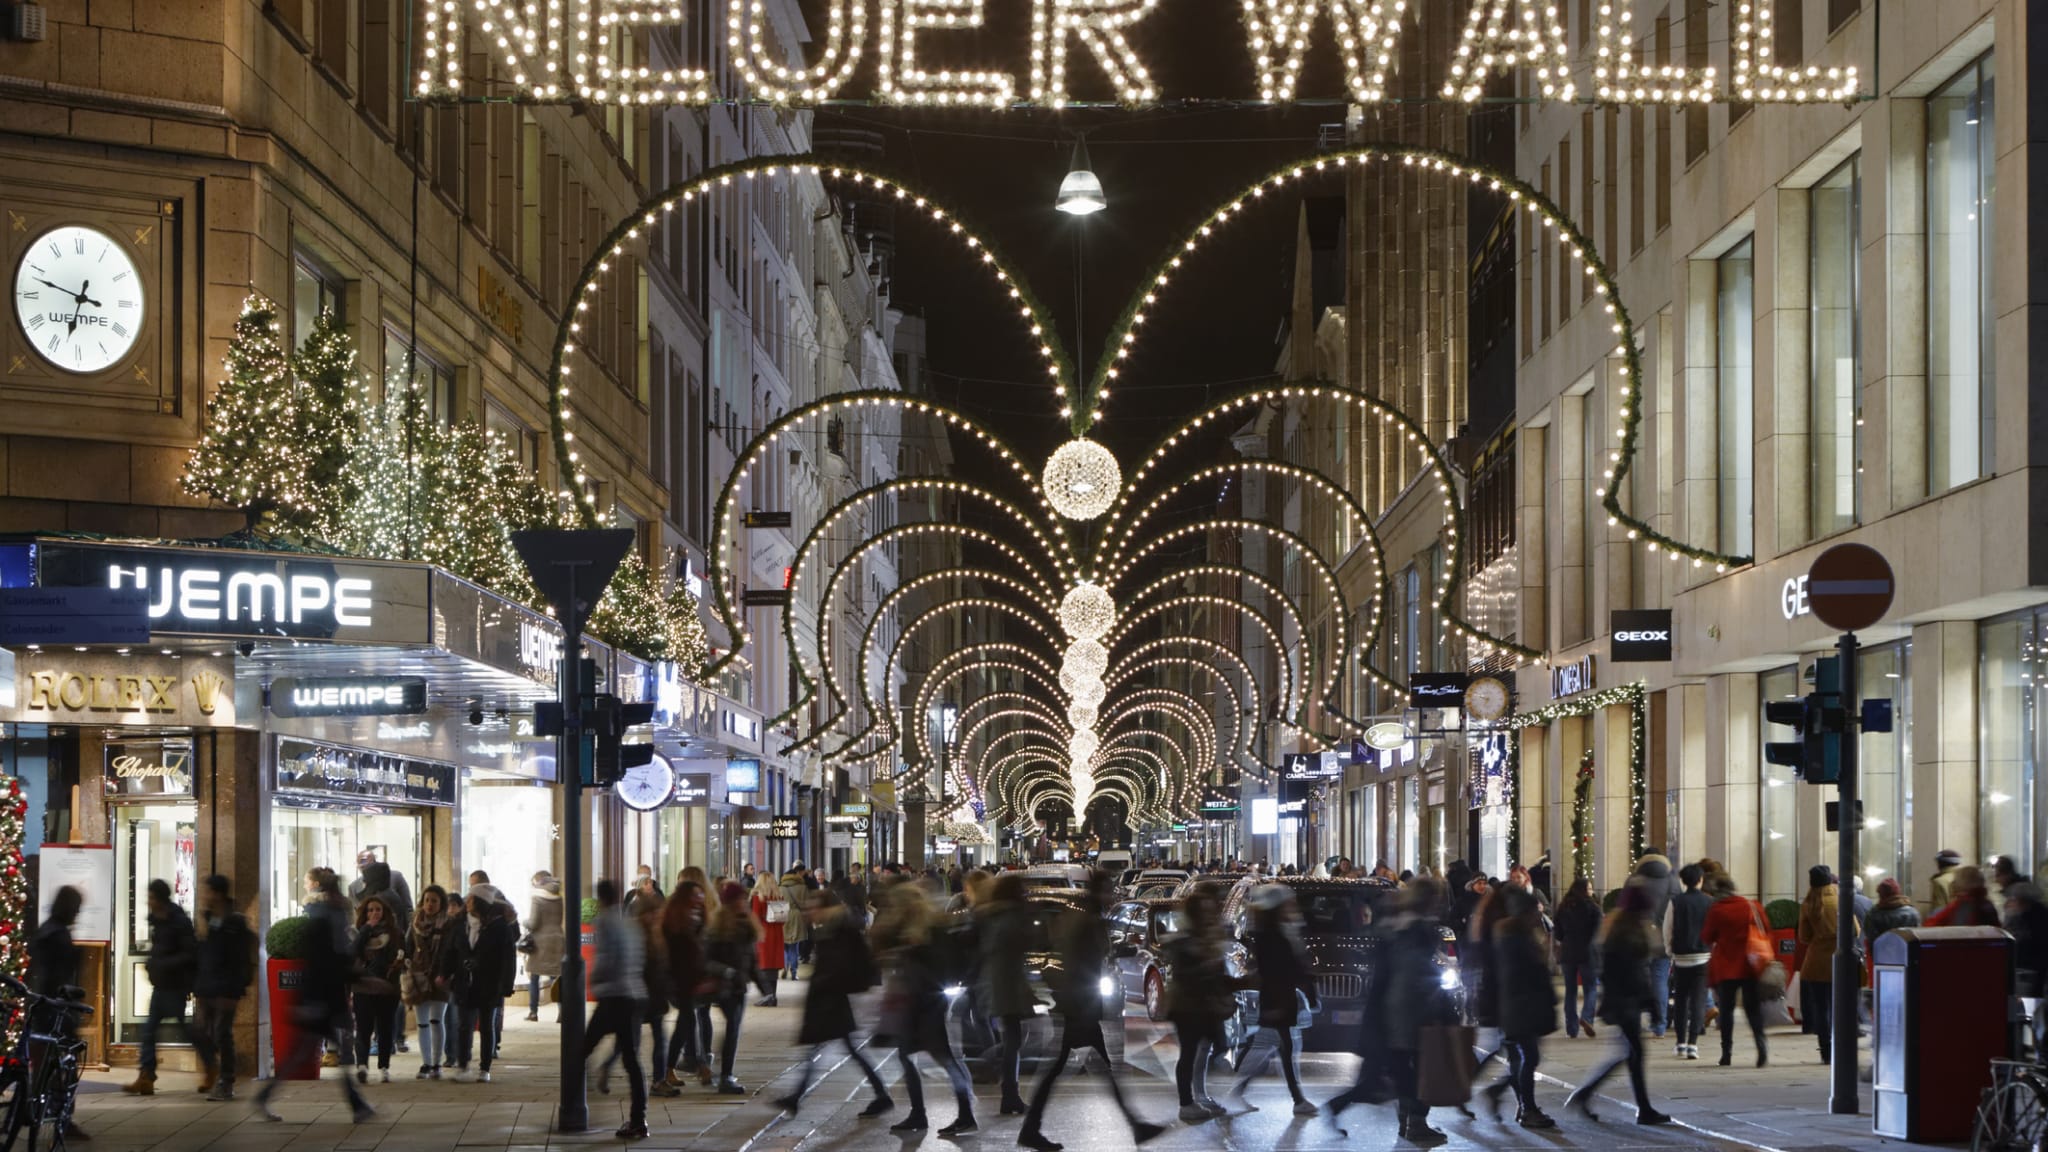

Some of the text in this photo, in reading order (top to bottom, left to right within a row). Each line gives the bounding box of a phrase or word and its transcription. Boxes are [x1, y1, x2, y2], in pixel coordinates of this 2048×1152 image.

[412, 0, 1859, 107] NEUER WALL
[49, 311, 109, 327] WEMPE
[1782, 573, 1810, 620] GE
[1614, 630, 1669, 642] GEOX
[30, 671, 177, 712] ROLEX
[1559, 662, 1581, 697] OMEGA
[293, 686, 404, 706] WEMPE
[111, 755, 186, 783] Chopard
[743, 822, 770, 830] MANGO
